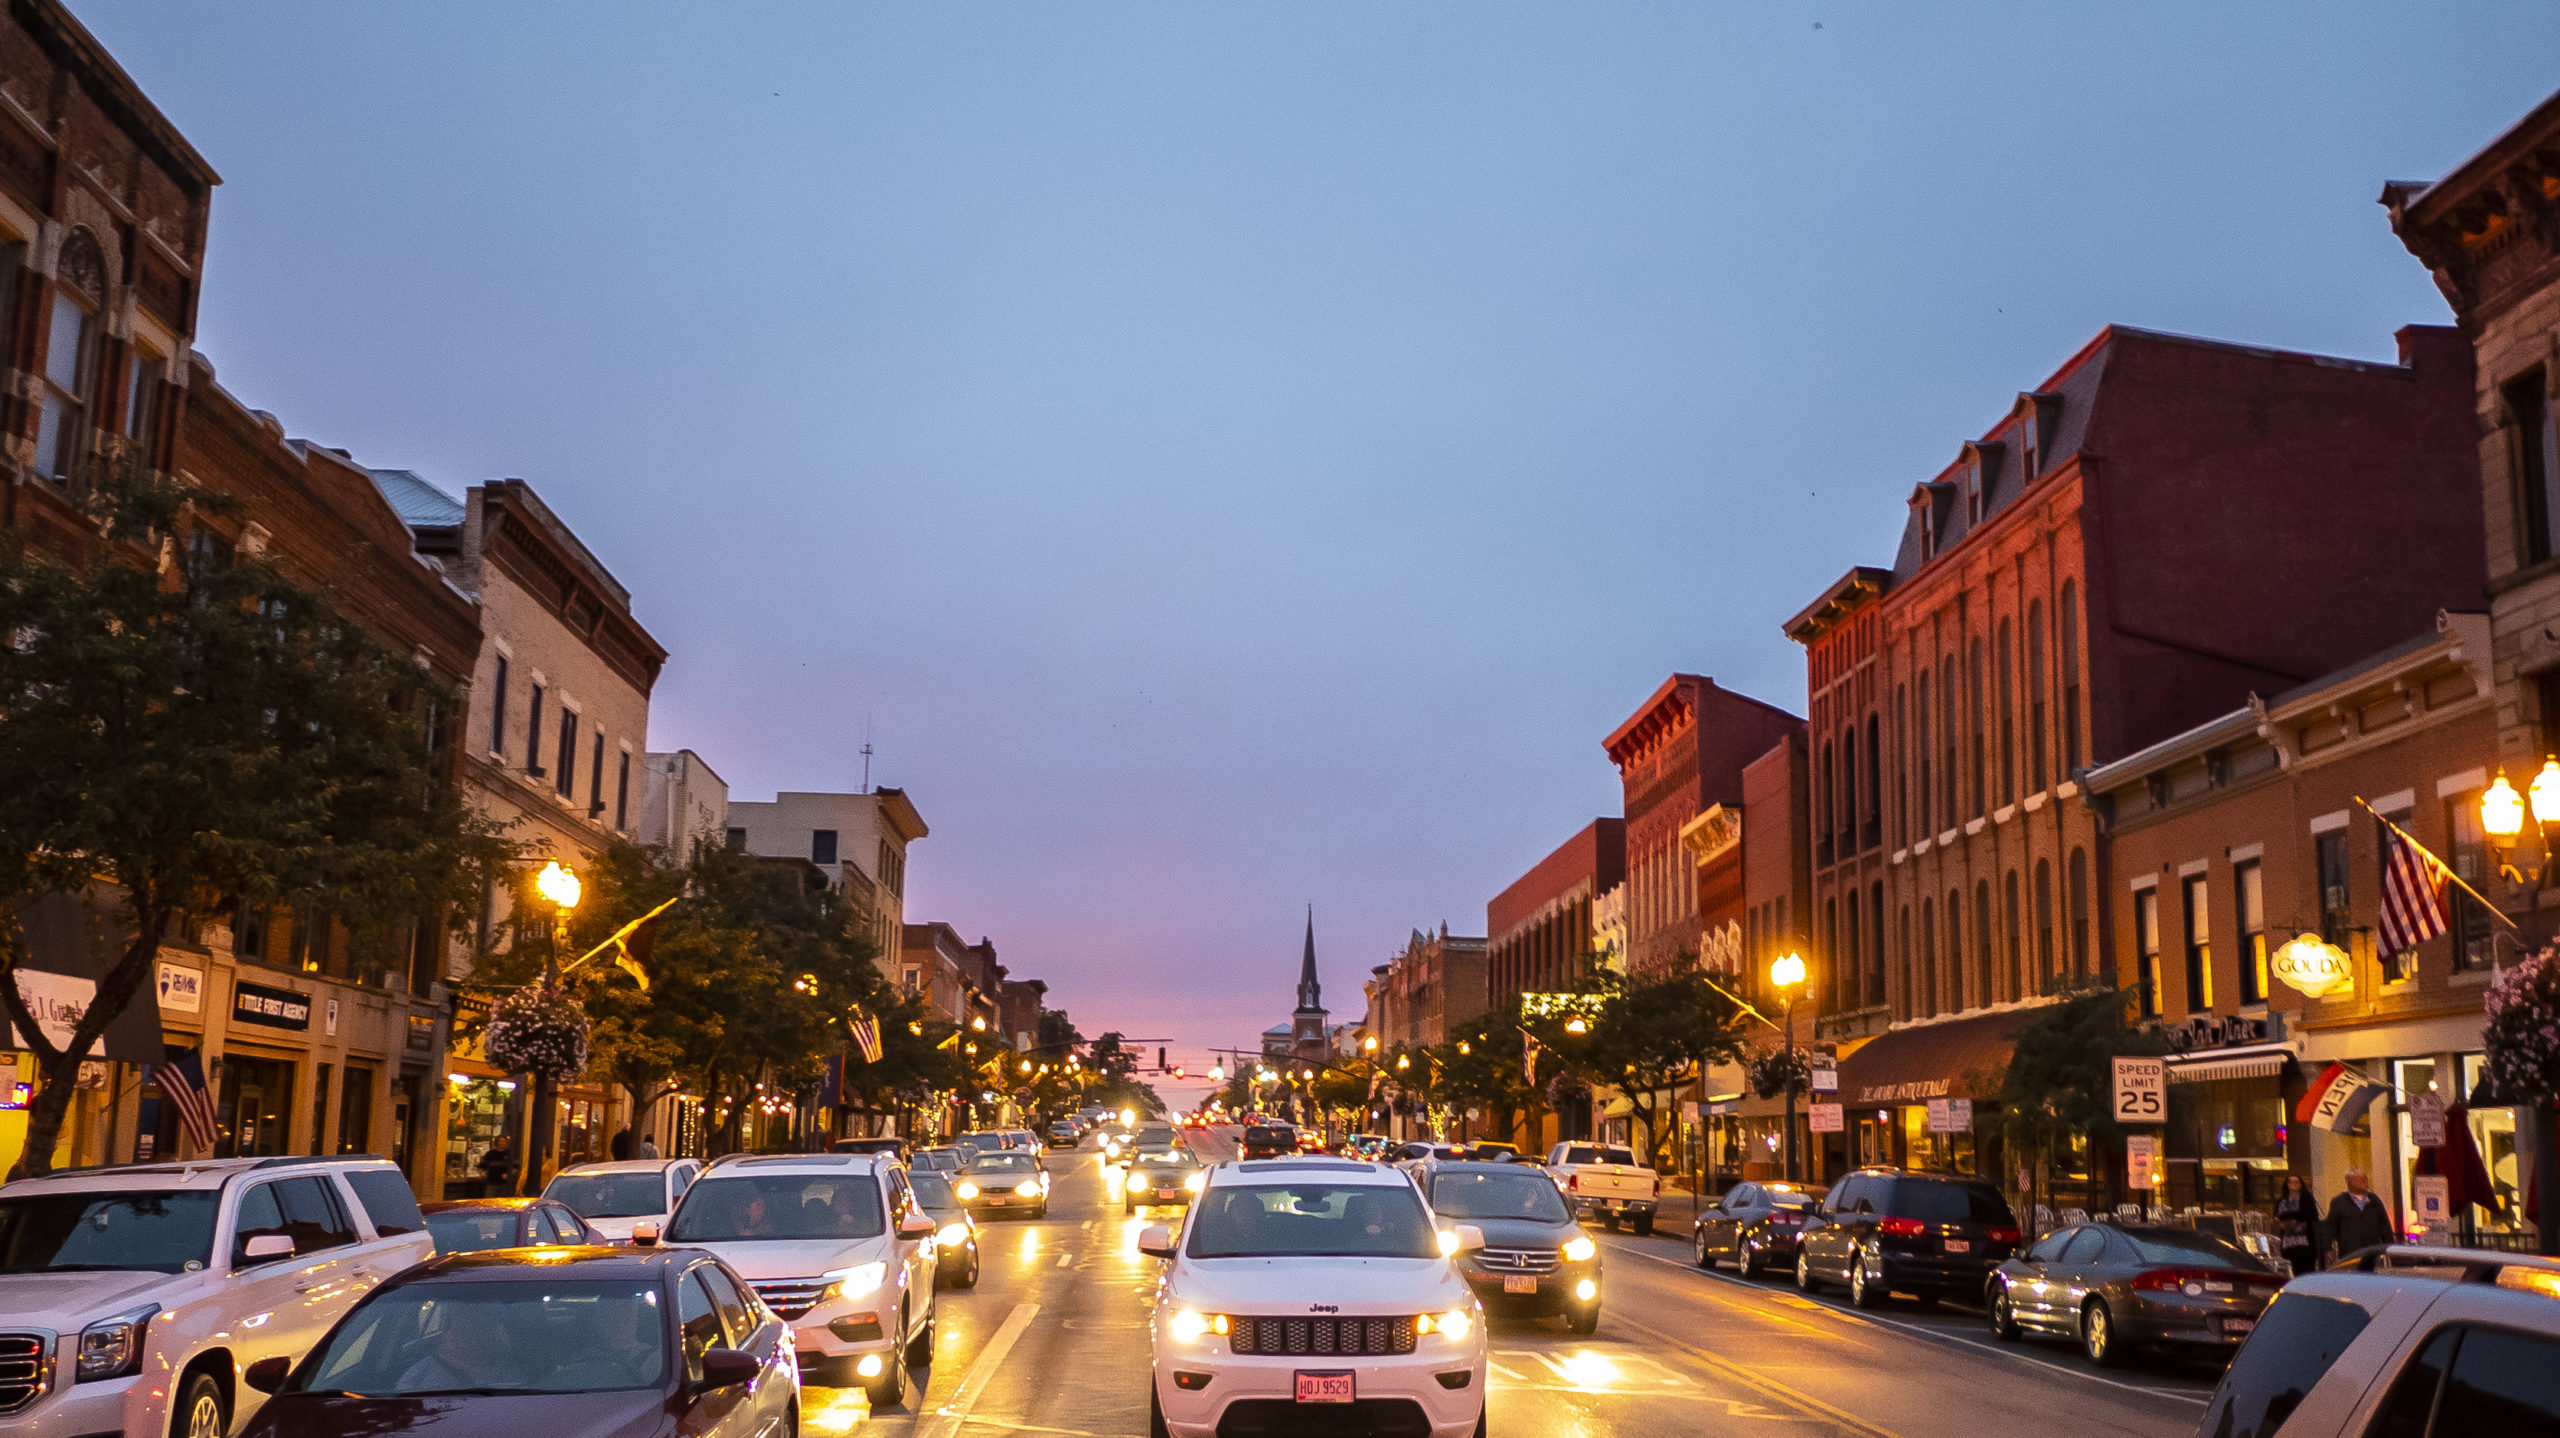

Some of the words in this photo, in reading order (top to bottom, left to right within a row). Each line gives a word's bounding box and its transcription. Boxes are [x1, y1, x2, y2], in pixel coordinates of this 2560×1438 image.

[2278, 957, 2344, 974] GOUDA
[2118, 1064, 2160, 1076] SPEED
[2122, 1078, 2156, 1089] LIMIT
[2120, 1091, 2161, 1114] 25
[1309, 1303, 1339, 1314] Jeep
[1300, 1380, 1320, 1395] HDJ
[1323, 1380, 1349, 1395] 9529
